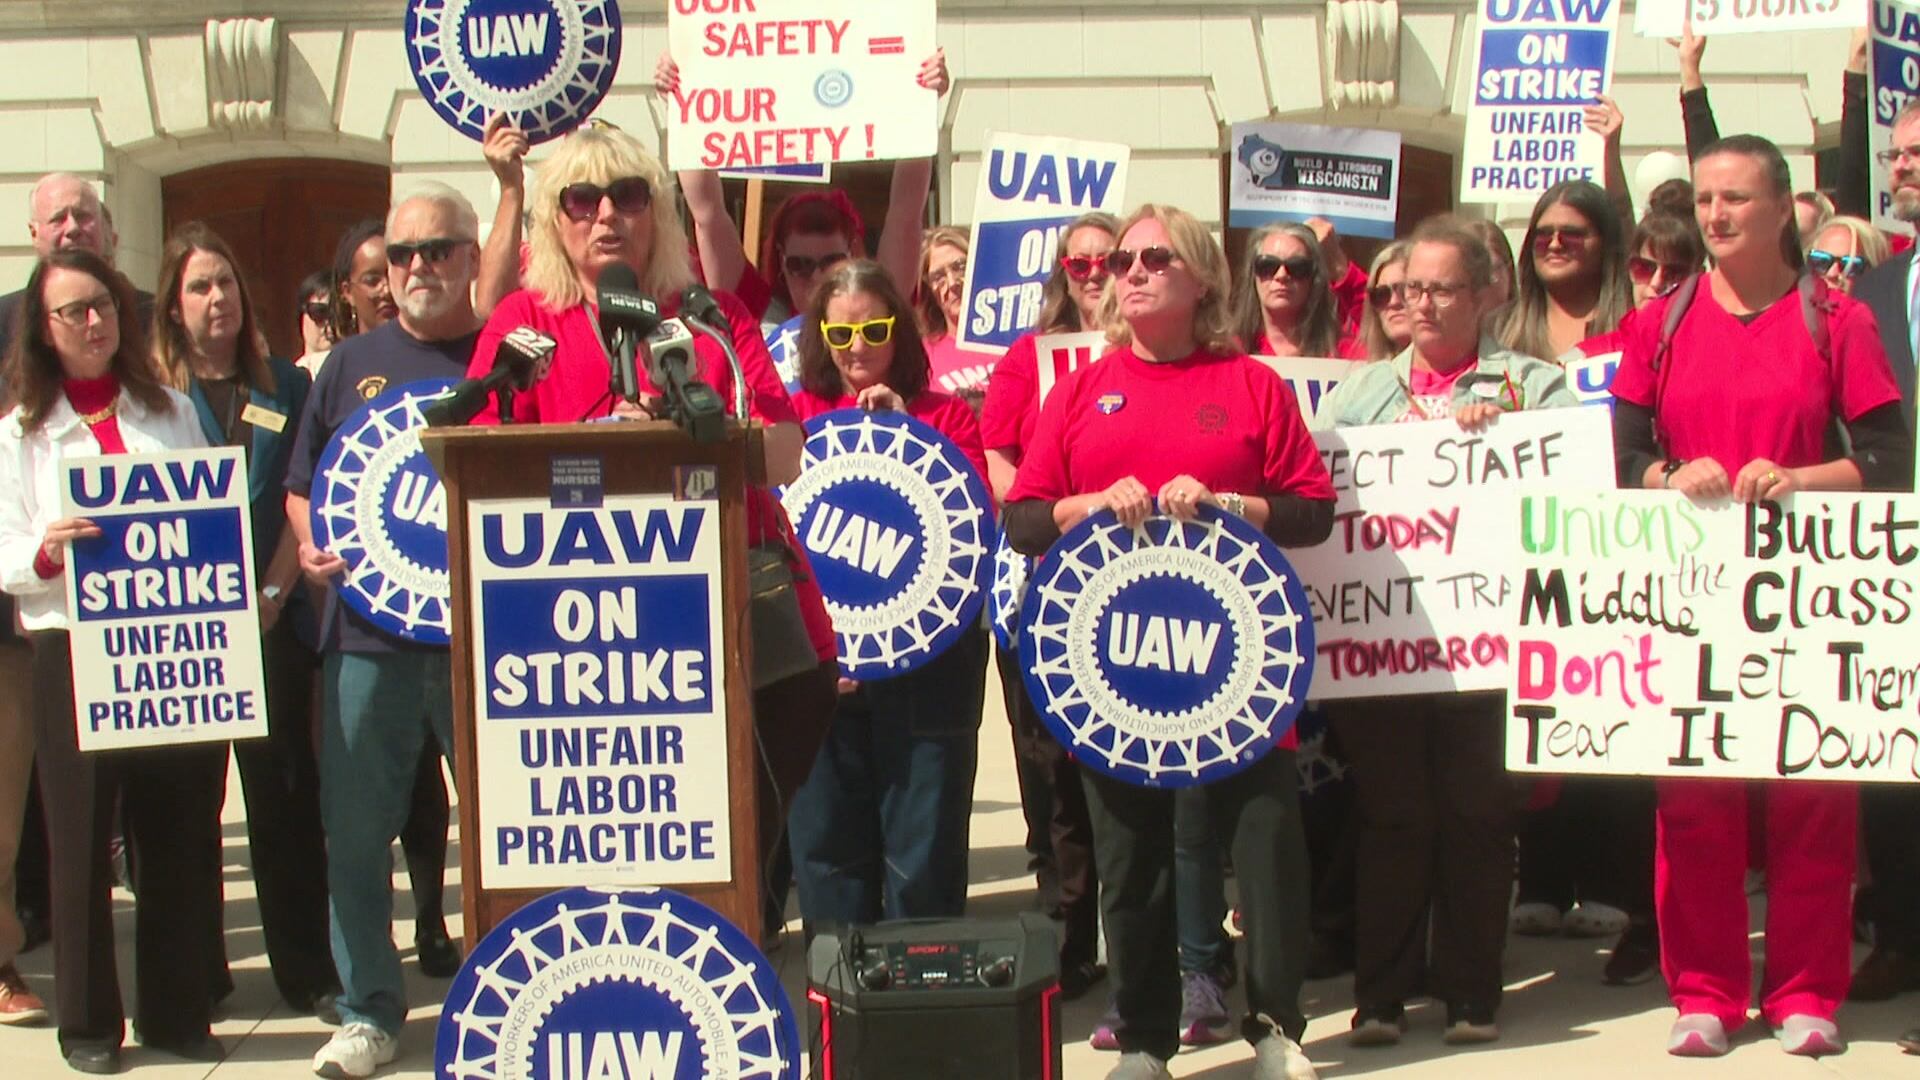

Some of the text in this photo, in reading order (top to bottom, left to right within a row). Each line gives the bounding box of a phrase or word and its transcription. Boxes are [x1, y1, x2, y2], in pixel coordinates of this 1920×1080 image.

[468, 13, 549, 59] UAW
[703, 19, 851, 57] SAFETY
[1873, 0, 1920, 42] UA
[1518, 33, 1568, 65] ON
[672, 87, 777, 124] YOUR
[1479, 68, 1601, 100] STRIKE
[1490, 111, 1583, 134] UNFAIR
[701, 126, 851, 168] SAFETY
[1294, 157, 1384, 175] BUILD A STRONGER
[1492, 139, 1576, 162] LABOR
[988, 149, 1117, 209] UAW
[1297, 169, 1380, 192] WISCONSIN
[611, 298, 641, 310] NEWS
[971, 281, 1044, 336] STR
[1428, 432, 1563, 488] STAFF
[69, 458, 236, 508] UAW
[392, 470, 447, 532] UA
[125, 518, 190, 562] ON
[482, 508, 706, 569] UAW
[806, 501, 915, 580] UAW
[1334, 506, 1460, 555] TODAY
[1521, 494, 1920, 566] Unions Built
[1103, 567, 1118, 585] OF
[1120, 552, 1173, 574] AMERICA
[1176, 557, 1220, 580] UNITED
[1671, 554, 1732, 598] the
[82, 563, 243, 612] STRIKE
[1073, 582, 1104, 635] WORKERS
[1520, 565, 1913, 637] Middle Class
[552, 586, 638, 643] ON
[104, 619, 229, 658] UNFAIR
[1107, 611, 1222, 675] UAW
[114, 656, 225, 694] LABOR
[492, 647, 706, 707] STRIKE
[1517, 634, 1664, 709] Don't
[1697, 637, 1801, 703] Let
[89, 690, 256, 733] PRACTICE
[1103, 701, 1186, 734] AGRICULTURAL
[1188, 711, 1214, 730] AND
[520, 725, 684, 769] UNFAIR
[1513, 703, 1920, 778] Tear It Down
[530, 774, 677, 817] LABOR
[497, 820, 715, 866] PRACTICE
[503, 998, 535, 1068] WORKERS
[531, 980, 549, 1000] OF
[551, 953, 614, 985] AMERICA
[619, 954, 673, 979] UNITED
